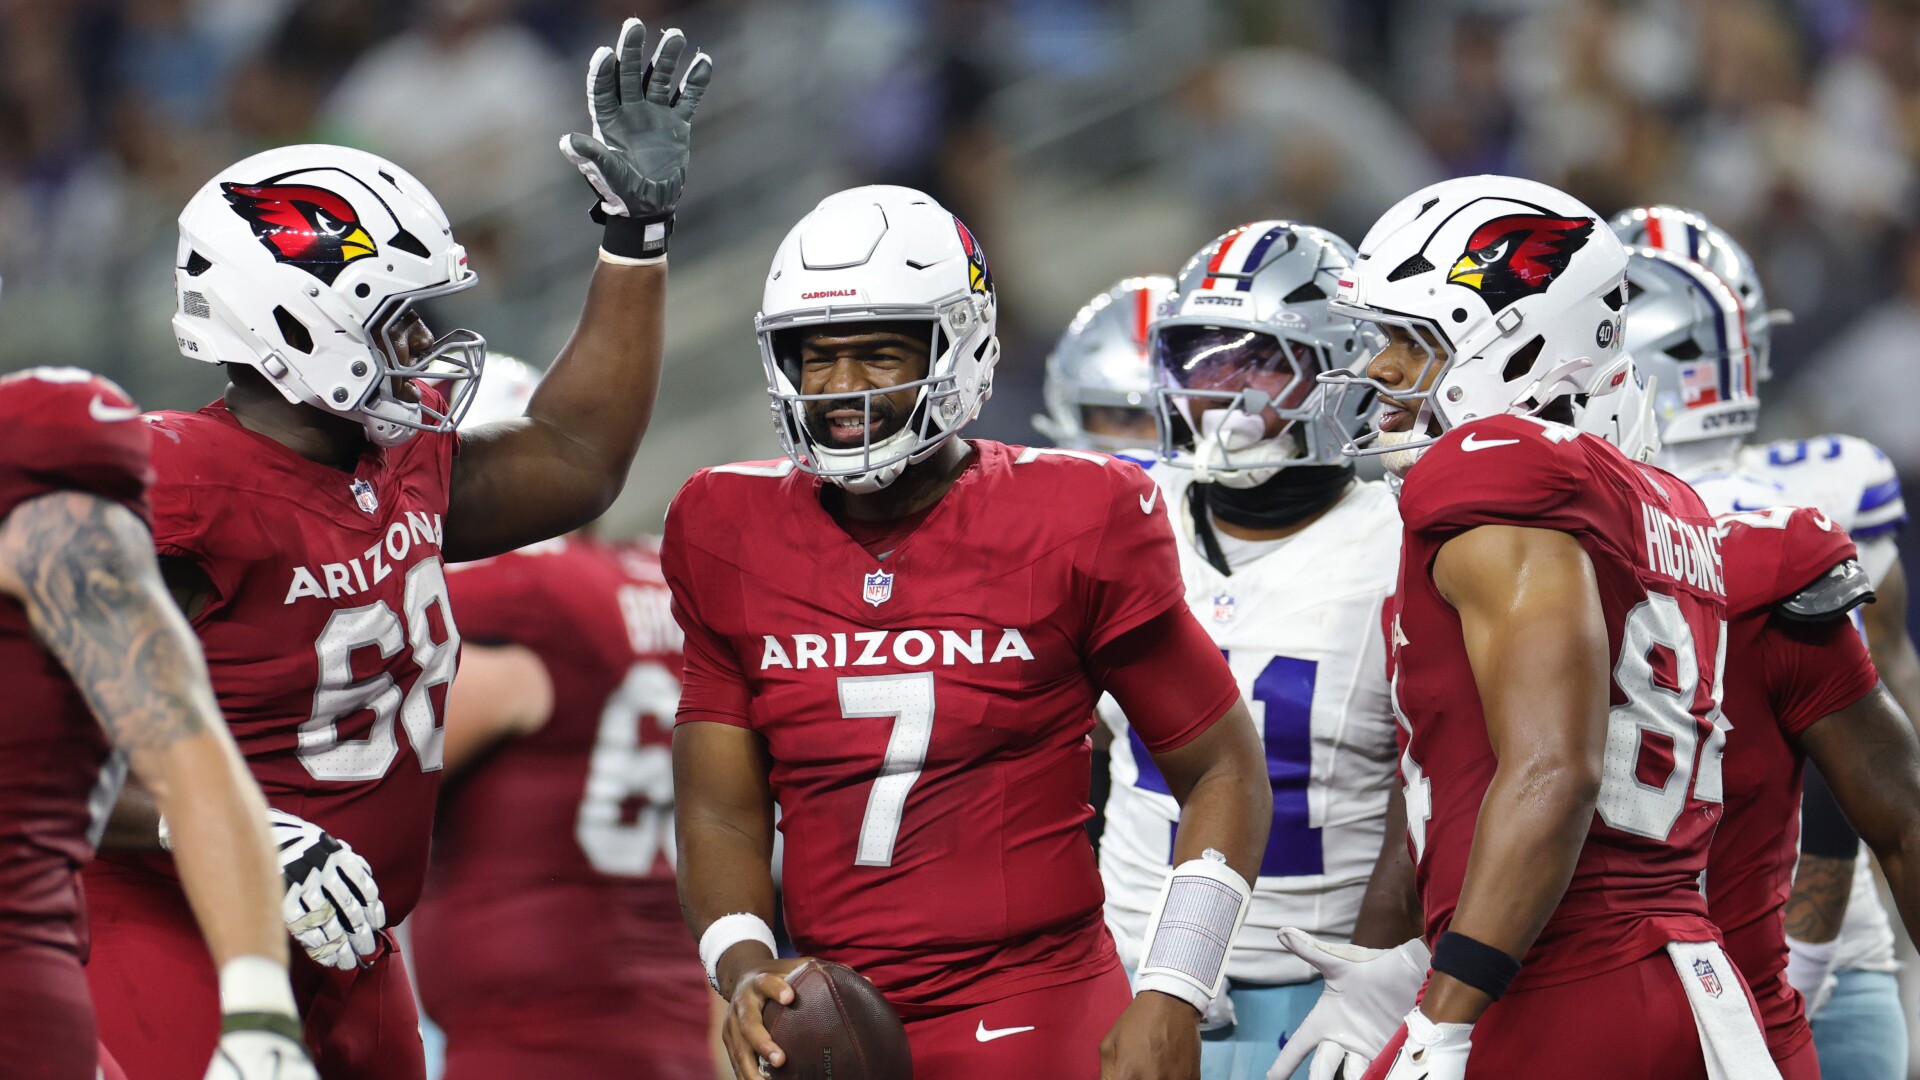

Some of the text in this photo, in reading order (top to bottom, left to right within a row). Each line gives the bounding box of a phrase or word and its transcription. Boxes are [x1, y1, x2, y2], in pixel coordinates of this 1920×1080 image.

[801, 288, 857, 300] CARDINALS
[1194, 296, 1244, 307] COWBOYS
[1598, 325, 1611, 342] 40
[187, 341, 198, 352] US
[1641, 501, 1727, 597] HIGGINS
[868, 586, 887, 597] NFL
[760, 628, 1035, 670] ARIZONA
[296, 556, 460, 781] 68
[574, 659, 677, 878] 6
[836, 671, 936, 867] 7
[1699, 974, 1720, 994] NFL
